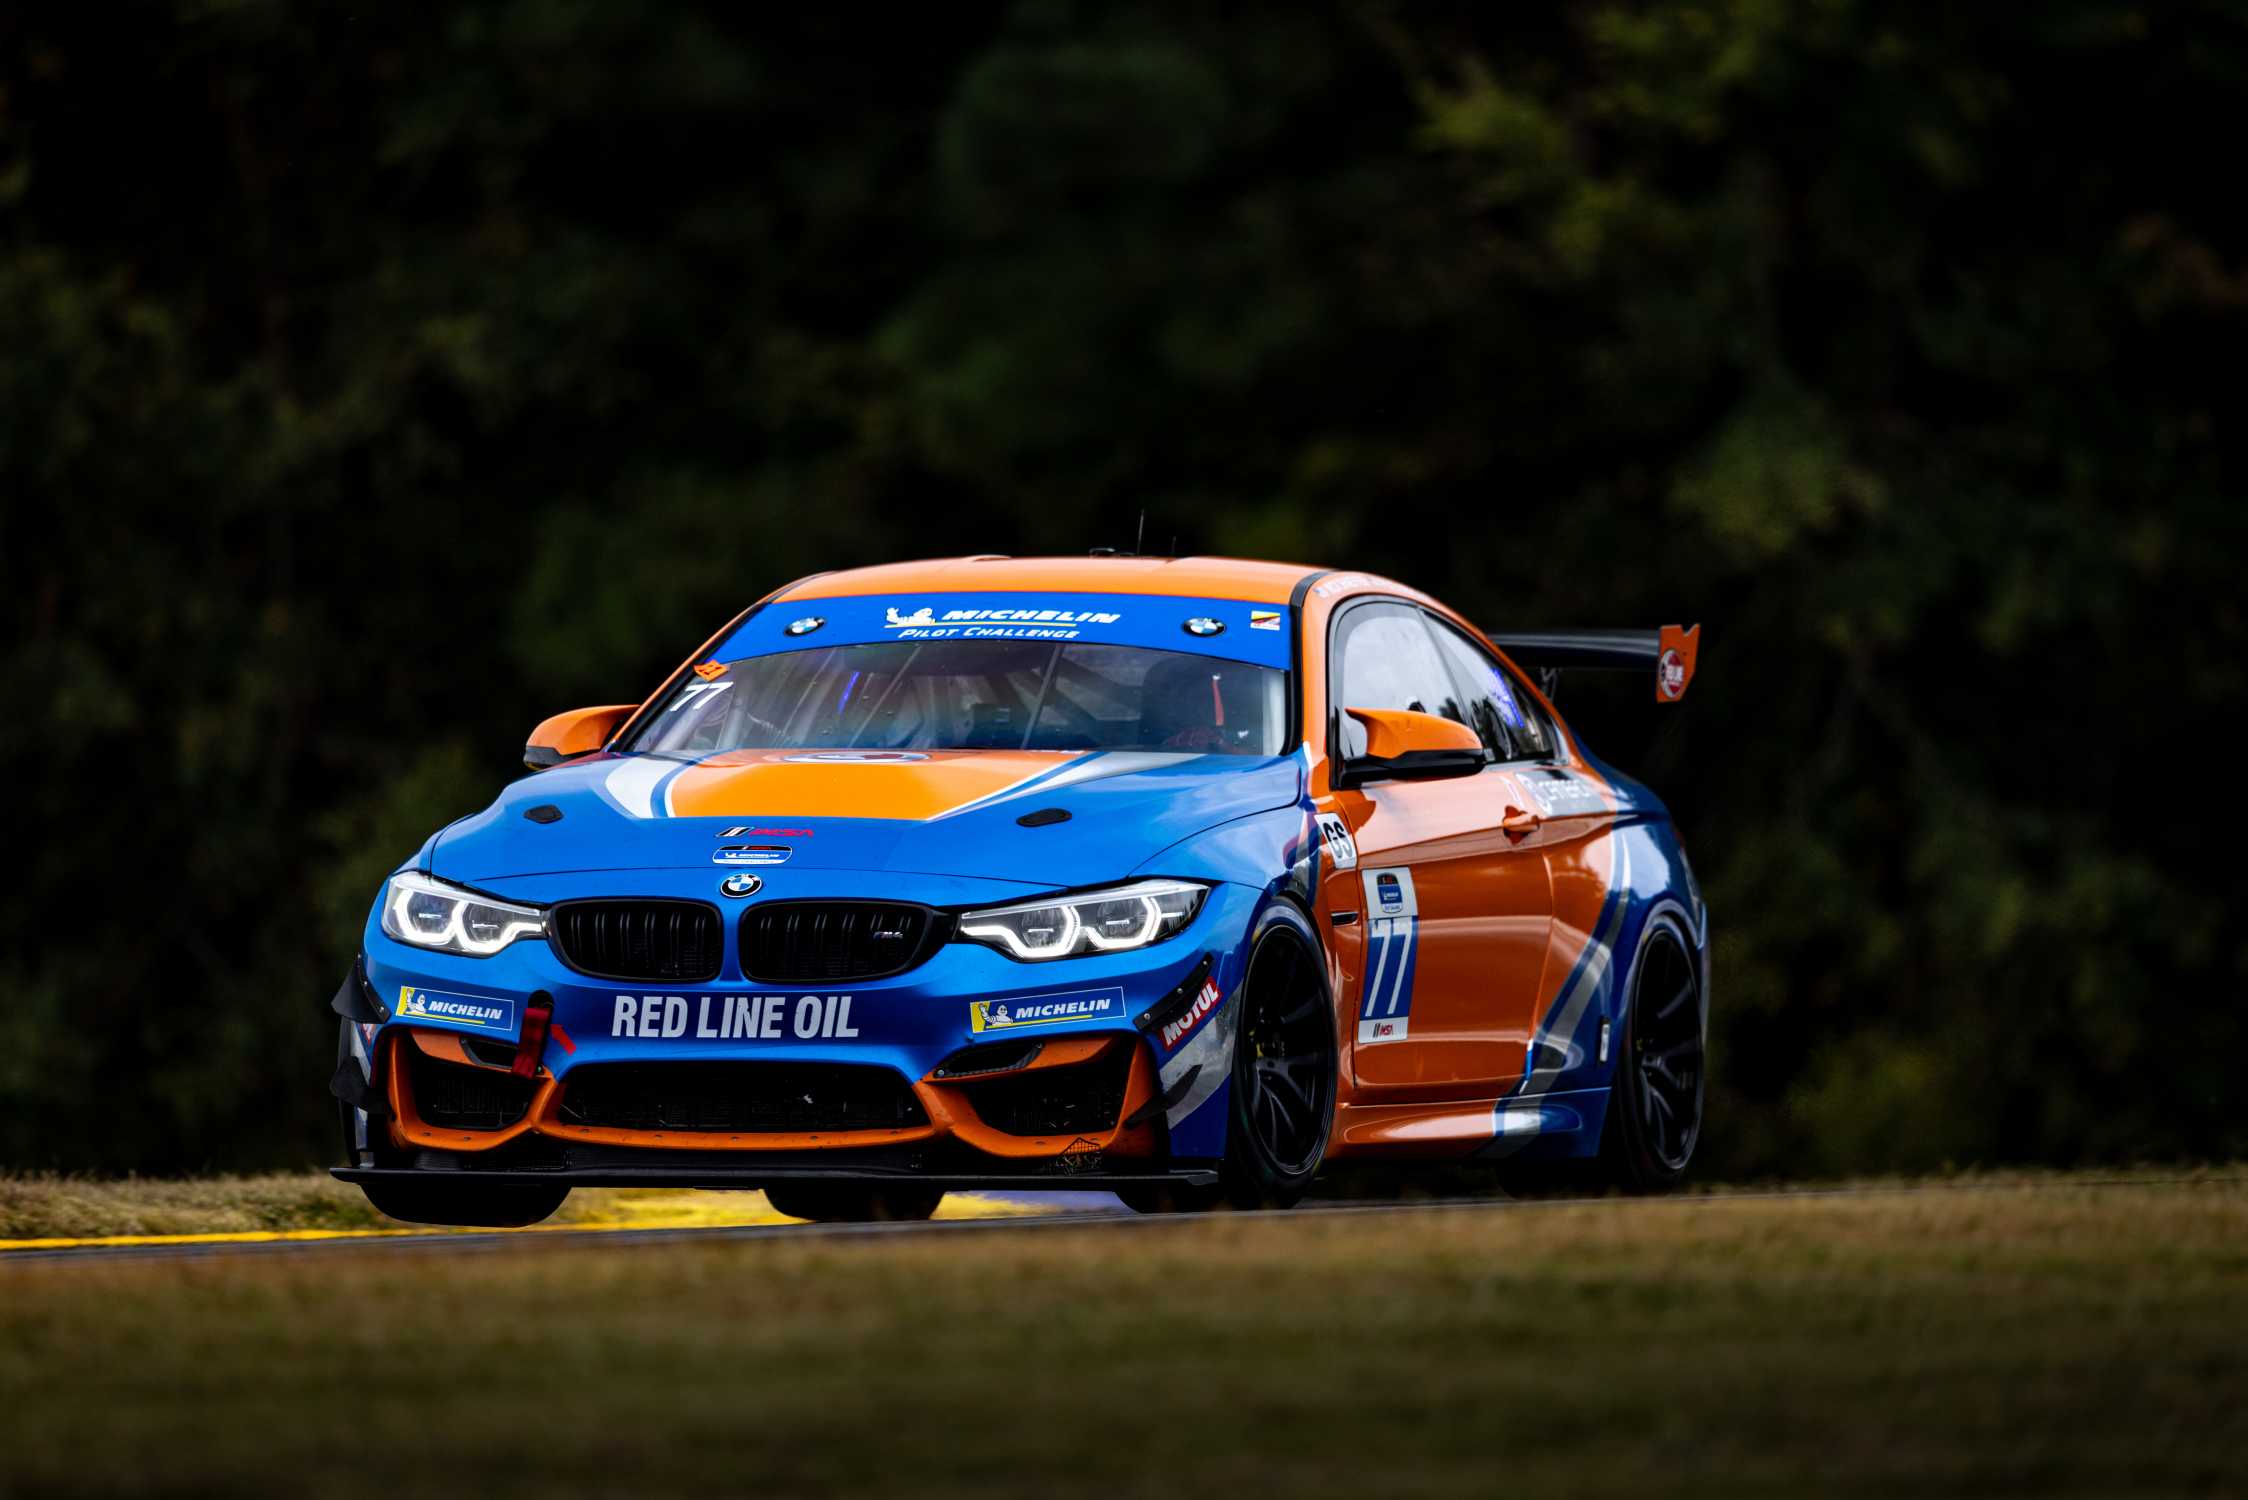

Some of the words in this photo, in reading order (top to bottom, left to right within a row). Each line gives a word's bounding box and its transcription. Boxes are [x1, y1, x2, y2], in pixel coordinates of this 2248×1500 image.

[941, 609, 1121, 624] MICHELIN
[898, 628, 959, 638] PILOT
[962, 626, 1080, 639] CHALLENGE
[669, 681, 734, 711] 77
[1322, 821, 1353, 858] GS
[1365, 916, 1414, 1017] 77
[428, 1000, 503, 1020] MICHELIN
[611, 995, 689, 1038] RED
[696, 997, 786, 1038] LINE
[793, 995, 859, 1039] OIL
[1015, 998, 1111, 1020] MICHELIN
[1163, 983, 1219, 1046] MOTUL
